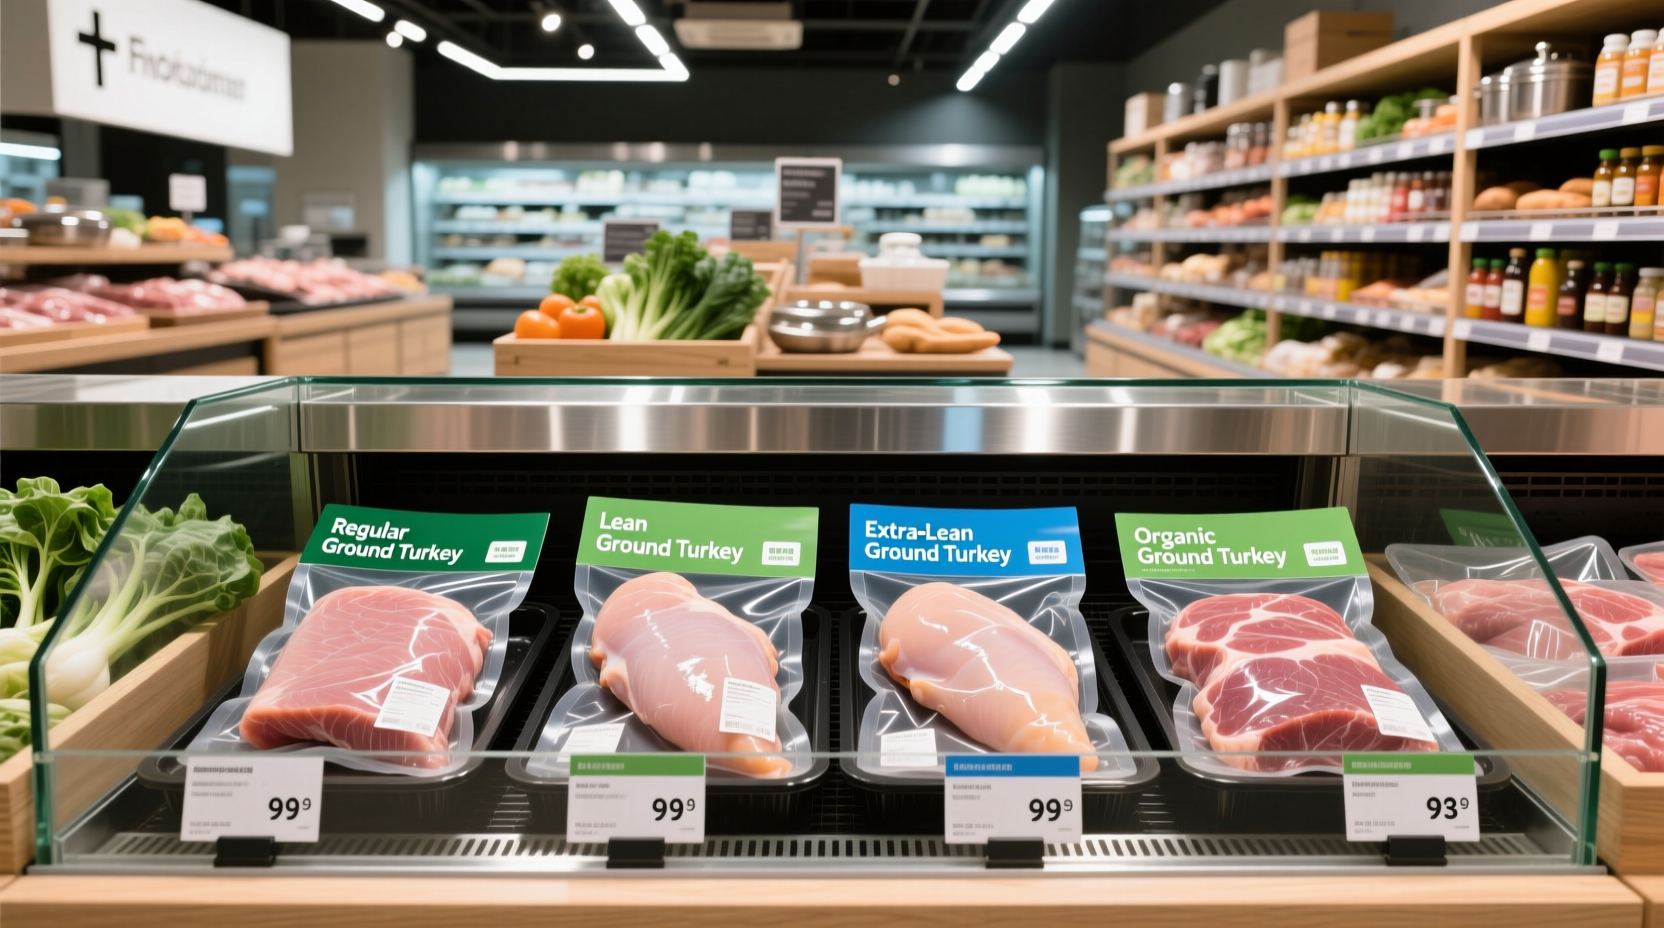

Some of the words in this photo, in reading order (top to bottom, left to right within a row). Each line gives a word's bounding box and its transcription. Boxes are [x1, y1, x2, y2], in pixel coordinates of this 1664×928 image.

[330, 517, 410, 541] Regular
[599, 511, 648, 532] Lean
[865, 520, 974, 541] Extra-Lean
[595, 533, 672, 557] Ground
[675, 539, 744, 565] Turkey
[1134, 526, 1217, 550] Organic
[321, 537, 396, 559] Ground
[398, 543, 464, 566] Turkey
[864, 542, 939, 562] Ground
[942, 544, 1012, 568] Turkey
[1137, 546, 1214, 565] Ground
[1216, 546, 1287, 569] Turkey
